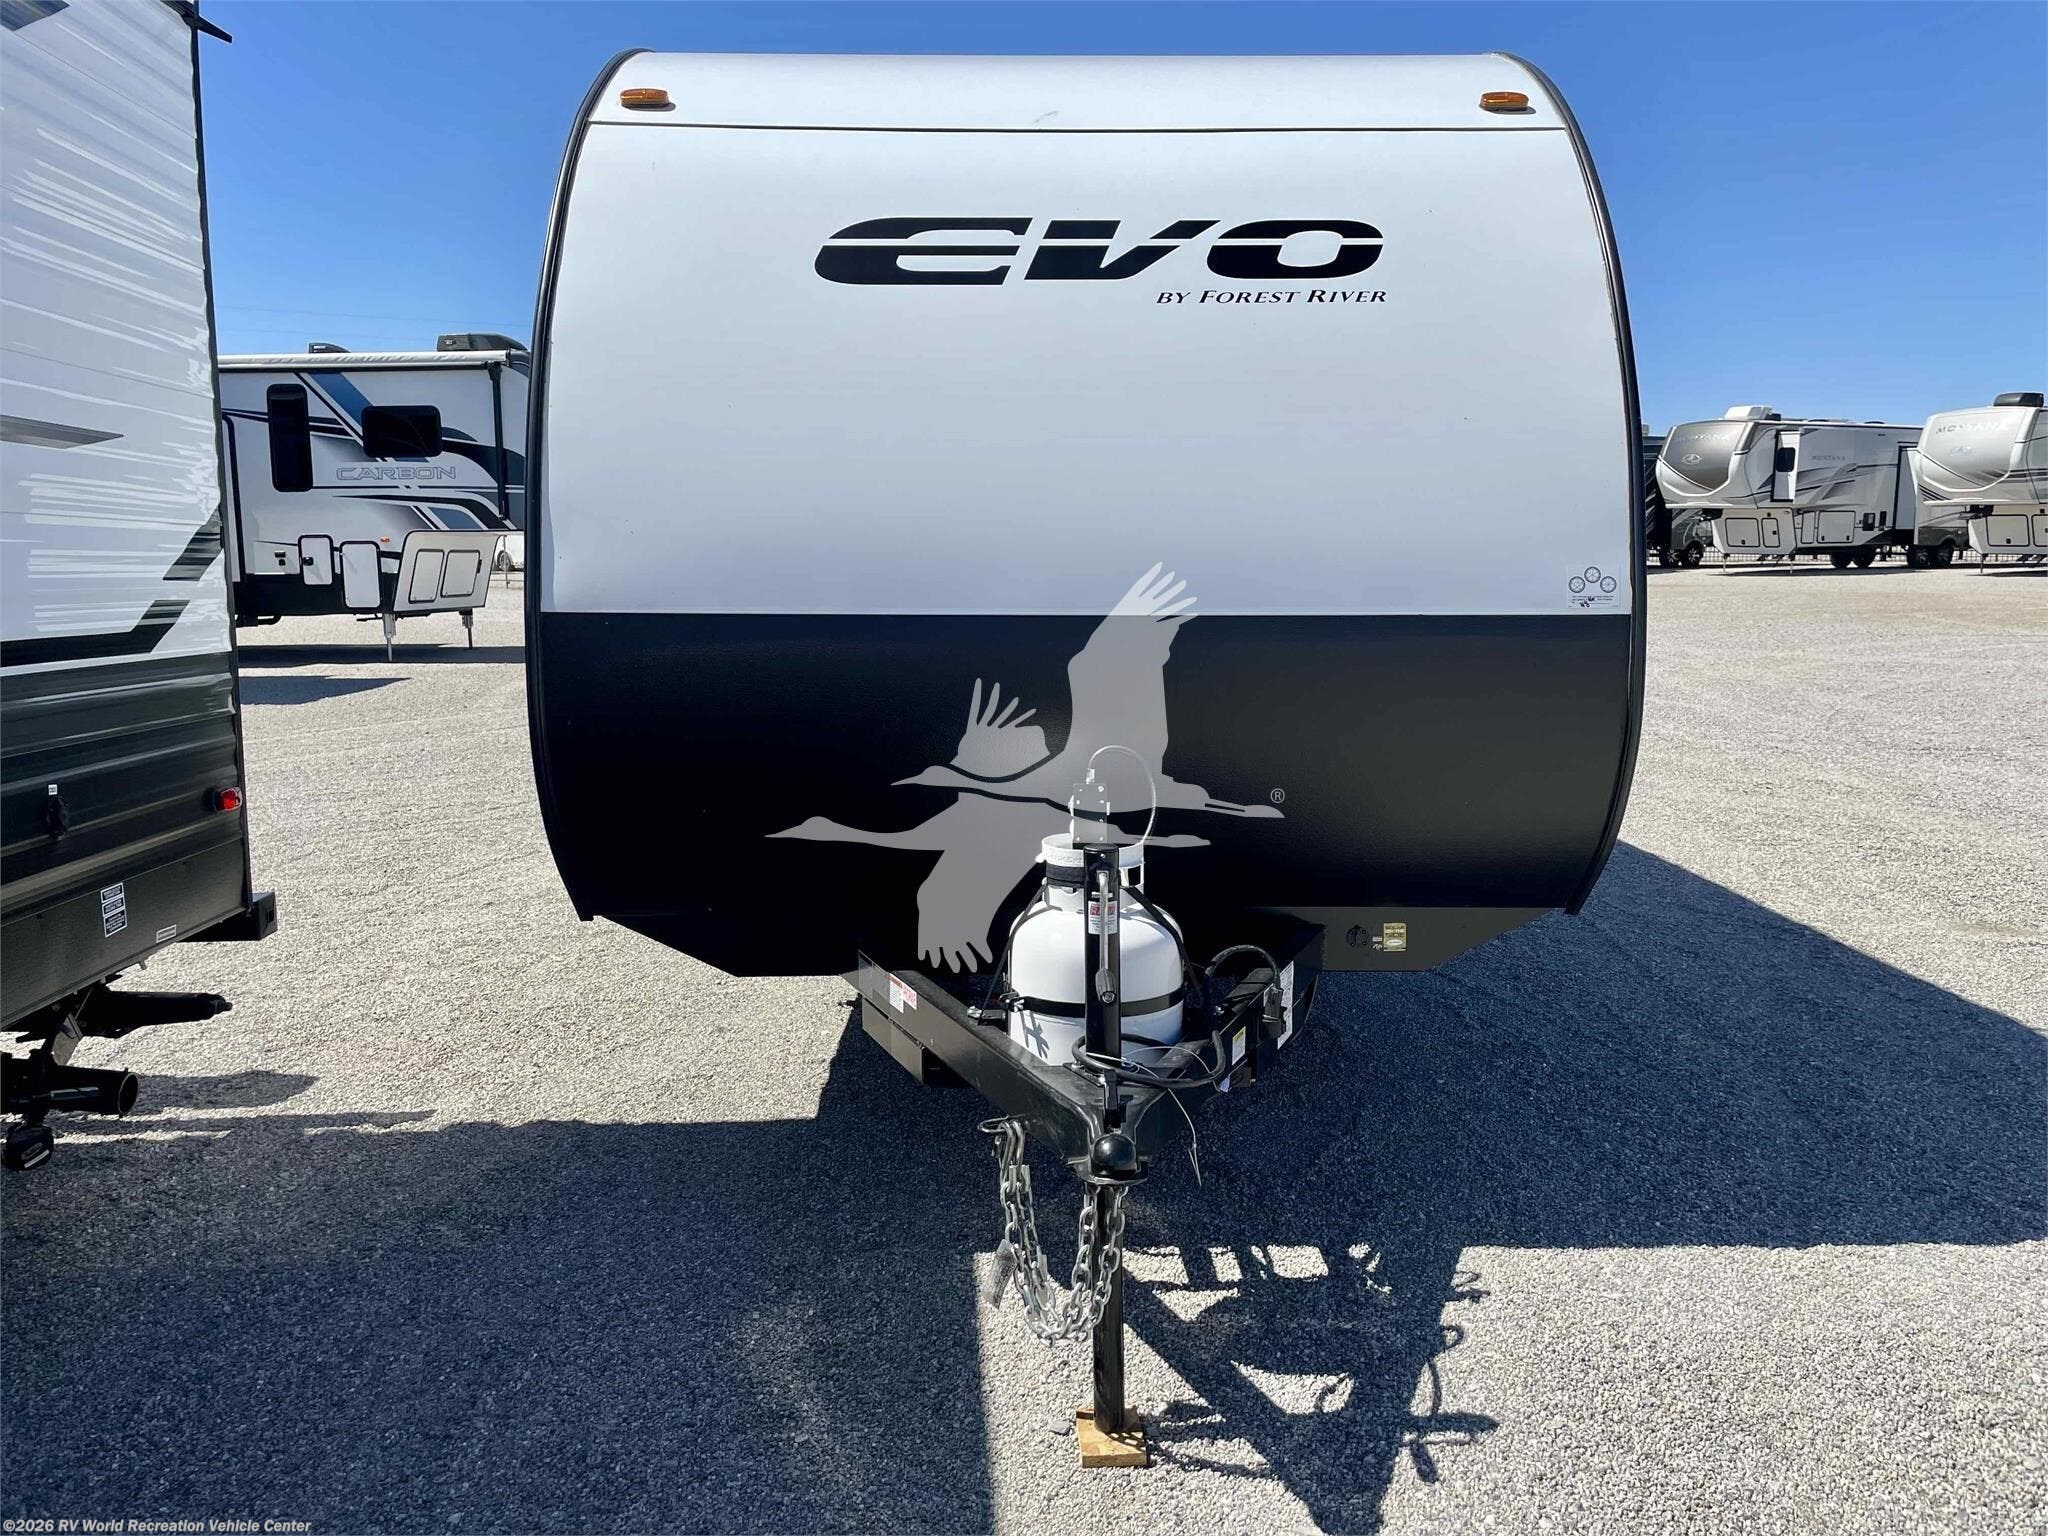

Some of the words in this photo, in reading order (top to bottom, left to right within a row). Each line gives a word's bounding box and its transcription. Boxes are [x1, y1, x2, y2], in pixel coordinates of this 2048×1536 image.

[814, 217, 1383, 285] EVO
[1156, 292, 1190, 304] BY
[336, 466, 456, 480] CARBON
